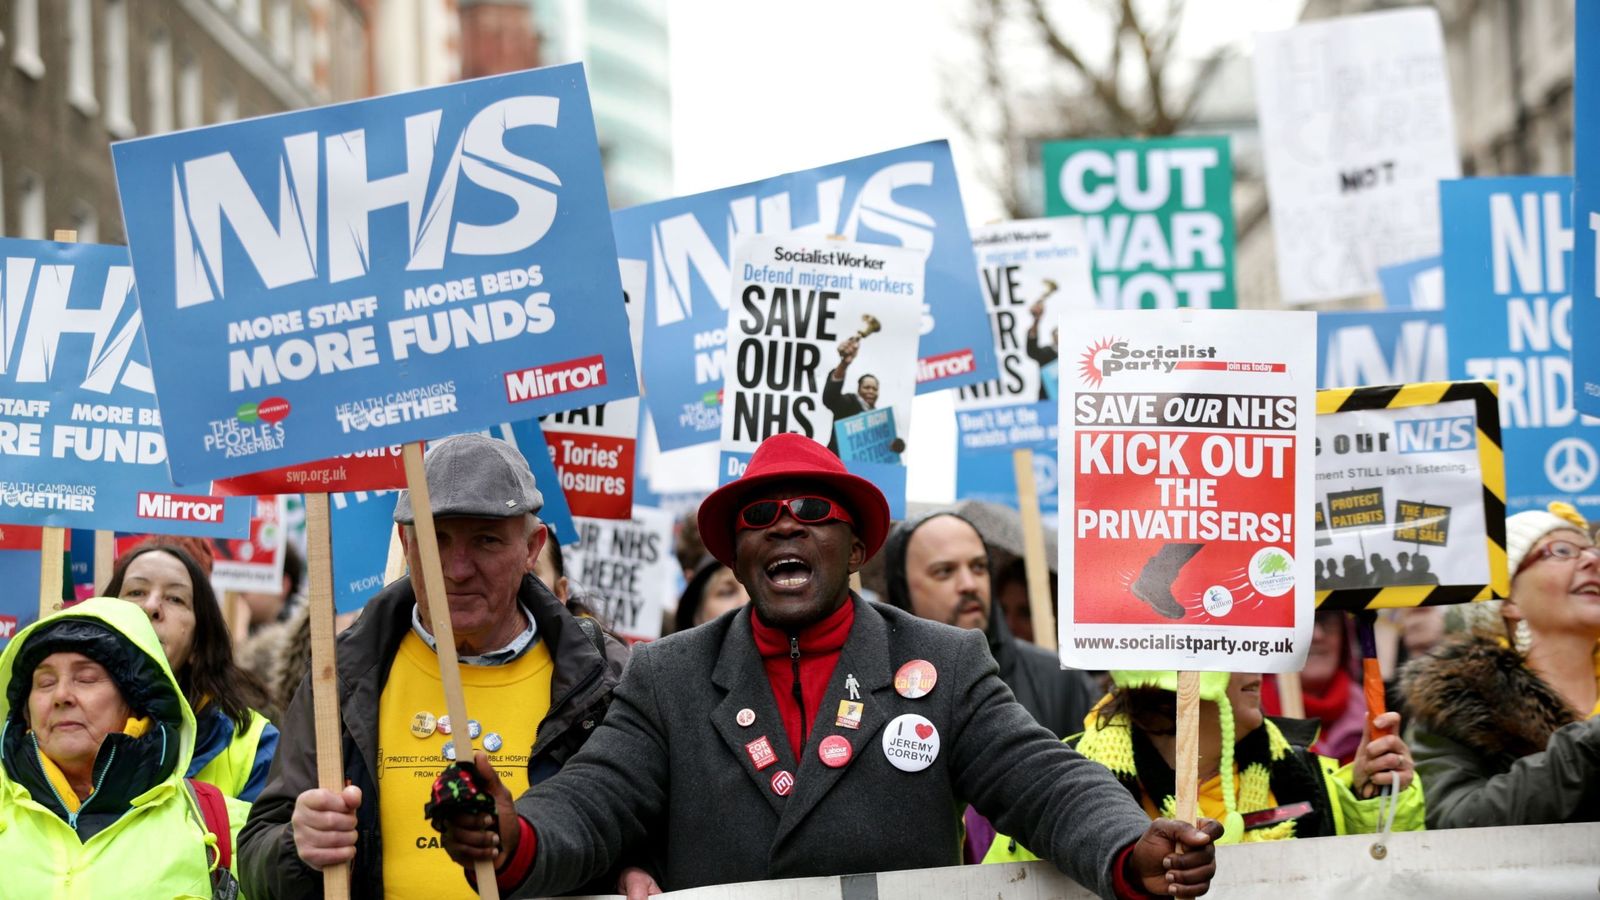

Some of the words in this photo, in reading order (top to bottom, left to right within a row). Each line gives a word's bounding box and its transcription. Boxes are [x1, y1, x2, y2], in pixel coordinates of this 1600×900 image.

[1059, 147, 1218, 213] CUT
[1340, 160, 1396, 194] NOT
[173, 95, 562, 309] NHS
[1489, 192, 1574, 294] NH
[773, 246, 834, 265] Socialist
[835, 252, 886, 271] Worker
[404, 275, 477, 312] MORE
[482, 264, 544, 296] BEDS
[743, 264, 793, 284] Defend
[799, 270, 853, 293] migrant
[859, 275, 914, 296] workers
[983, 265, 1025, 307] VE
[228, 311, 304, 345] MORE
[308, 296, 378, 330] STAFF
[739, 285, 840, 342] SAVE
[1506, 295, 1573, 352] NO
[229, 326, 380, 393] MORE
[388, 292, 556, 361] FUNDS
[1110, 341, 1217, 359] Socialist
[736, 338, 821, 394] OUR
[917, 353, 973, 384] irror
[1242, 364, 1251, 372] us
[1251, 363, 1273, 373] today
[506, 361, 604, 403] Mirror
[1465, 357, 1578, 428] TRID
[335, 396, 384, 415] HEALTH
[386, 380, 457, 405] CAMPAIGNS
[1075, 395, 1157, 425] SAVE
[1163, 397, 1222, 424] OUR
[1226, 397, 1297, 429] NHS
[0, 399, 50, 418] TAFF
[71, 403, 134, 424] MORE
[138, 408, 162, 426] BE
[208, 417, 240, 436] THE
[733, 391, 815, 443] NHS
[844, 416, 866, 435] THE
[0, 421, 42, 457] RE
[52, 425, 168, 465] FUND
[225, 436, 286, 459] ASSEMBLY
[847, 422, 890, 451] TAKING
[1334, 432, 1391, 455] our
[1399, 418, 1474, 452] NHS
[561, 439, 623, 469] Tories'
[1080, 433, 1190, 475] KICK
[1200, 435, 1292, 479] OUT
[286, 466, 347, 486] swp.org.uk
[558, 465, 626, 496] losures
[1347, 467, 1383, 478] STILL
[1386, 465, 1413, 476] isn't
[0, 481, 35, 493] EALTH
[37, 483, 97, 497] CAMPAIGNS
[1154, 478, 1218, 507] THE
[1331, 492, 1380, 511] PROTECT
[138, 493, 223, 522] Mirror
[1331, 509, 1385, 528] PATIENTS
[1401, 503, 1420, 517] THE
[1077, 509, 1293, 543] PRIVATISERS!
[1396, 527, 1417, 540] FOR
[1418, 528, 1447, 543] SALE
[571, 521, 601, 551] UR
[611, 526, 662, 564] NHS
[349, 573, 385, 593] PEOPL
[582, 558, 641, 594] HERE
[1254, 575, 1296, 587] Conservatives
[1206, 599, 1232, 613] carillion
[1074, 634, 1294, 656] www.socialistparty.org.uk
[897, 721, 903, 736] I
[748, 740, 768, 754] COR
[751, 748, 772, 762] BYN
[823, 746, 848, 755] Labour
[887, 747, 933, 764] CORBYN
[890, 738, 934, 753] JEREMY
